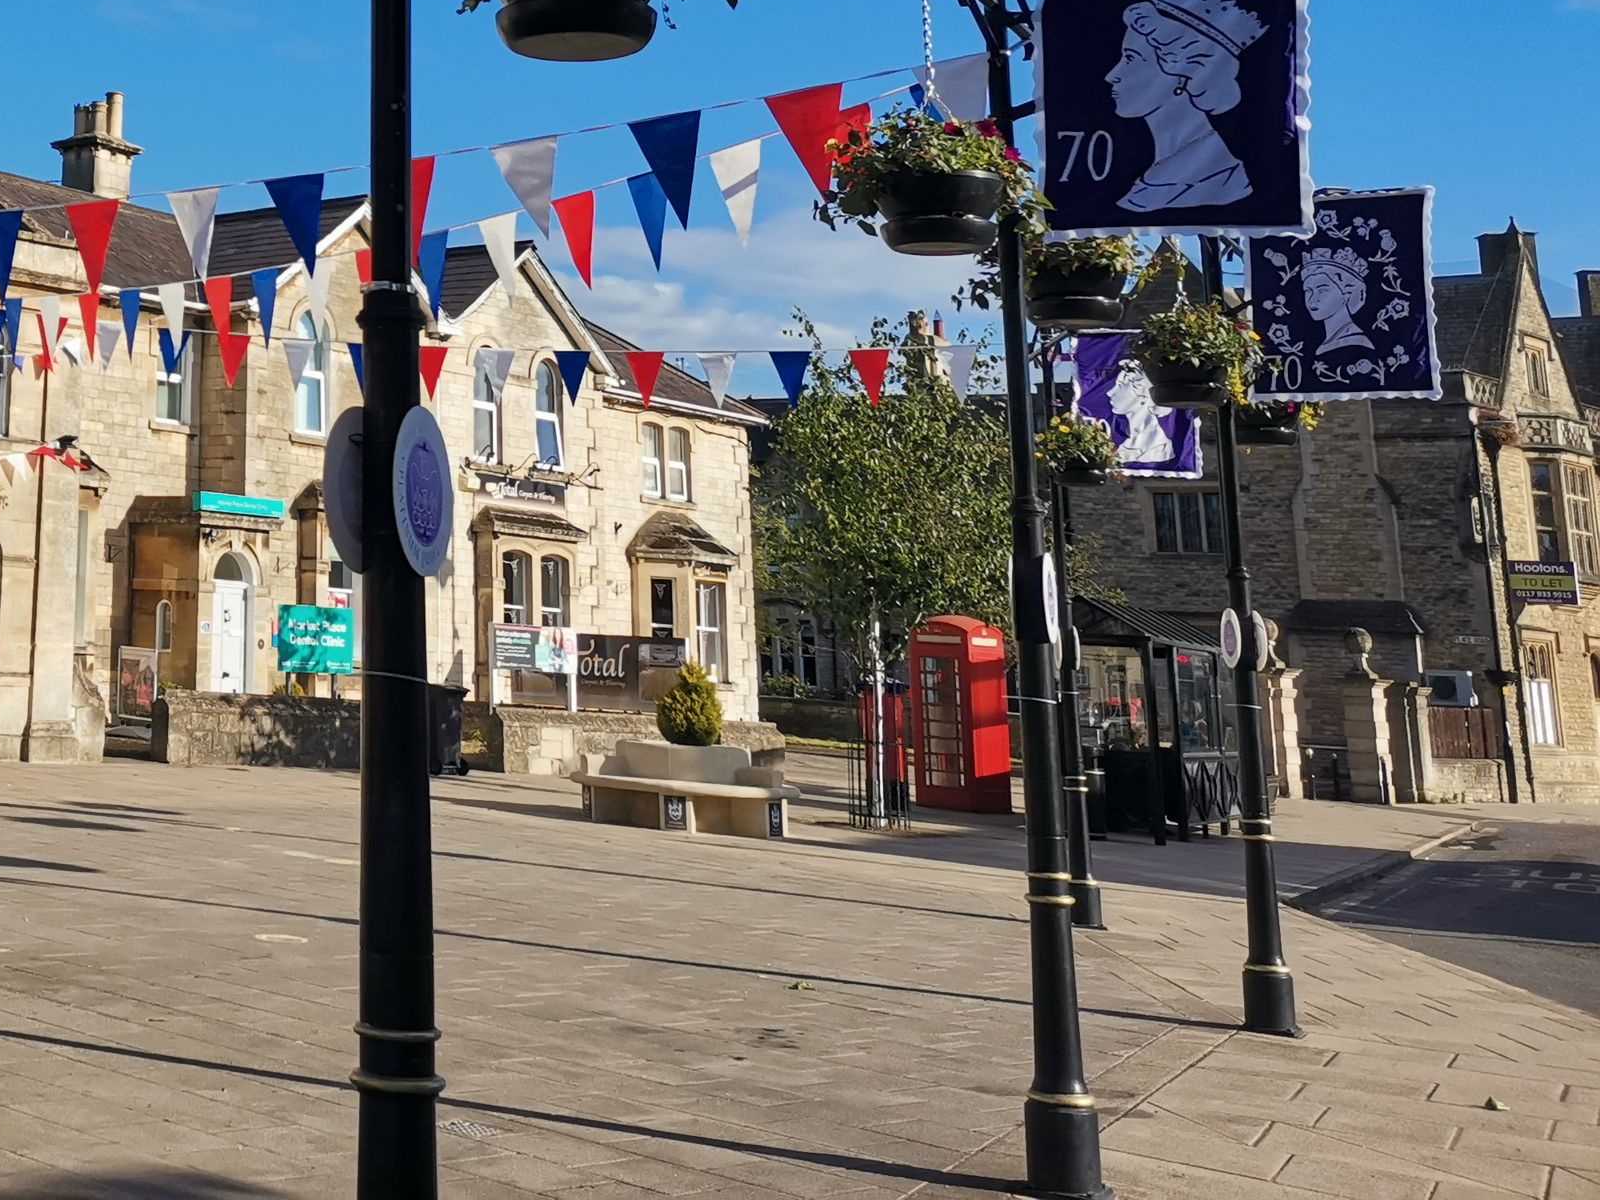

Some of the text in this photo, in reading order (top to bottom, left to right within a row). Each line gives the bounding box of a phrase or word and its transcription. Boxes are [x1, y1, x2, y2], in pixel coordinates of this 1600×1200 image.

[1057, 130, 1113, 182] 70
[1263, 355, 1302, 391] 70
[1521, 577, 1563, 588] TO LET
[1516, 590, 1535, 598] 0117
[288, 618, 347, 633] Market Place
[289, 633, 346, 648] Dental Clinic
[578, 639, 630, 678] otal
